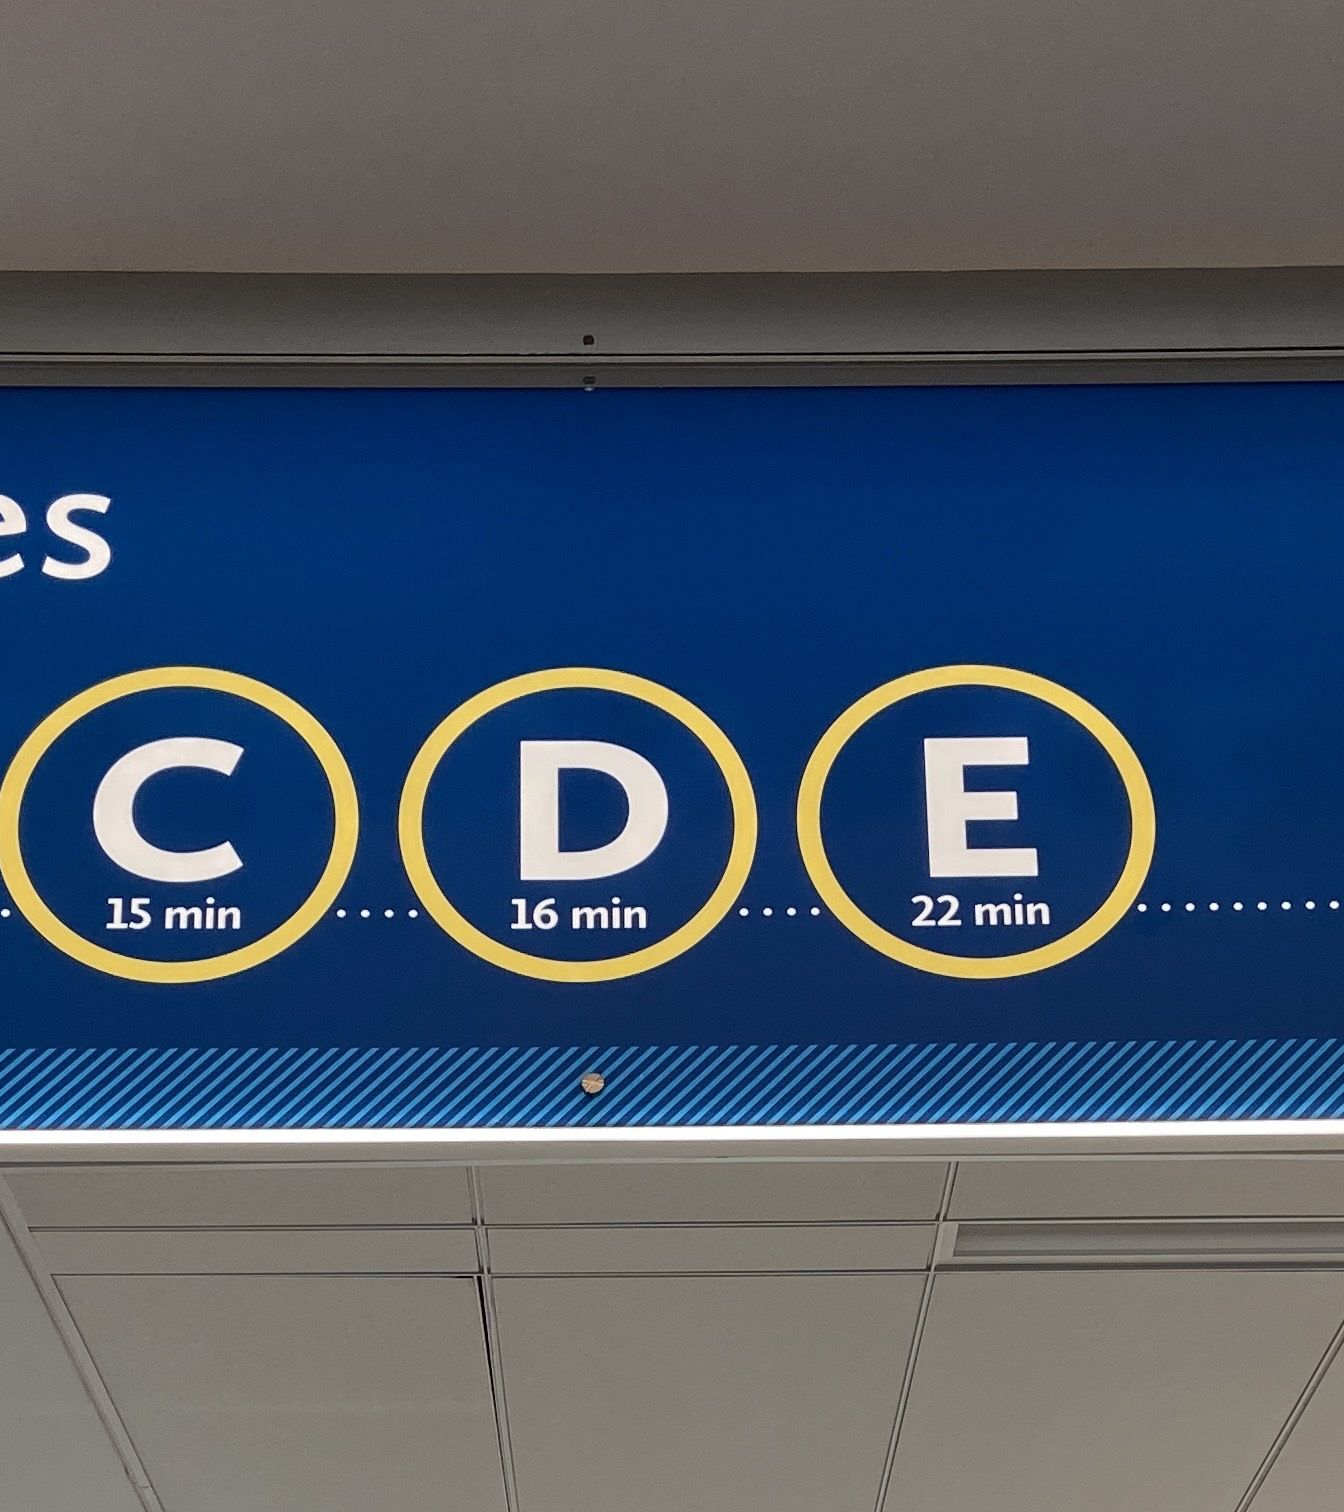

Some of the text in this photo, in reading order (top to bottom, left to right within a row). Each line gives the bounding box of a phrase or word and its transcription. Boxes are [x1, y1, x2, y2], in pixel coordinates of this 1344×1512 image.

[92, 736, 245, 883] C
[519, 739, 670, 882] D
[923, 736, 1039, 879] E
[105, 896, 243, 930] 15 min
[510, 896, 648, 931] 16 min
[910, 894, 1052, 927] 22 min
